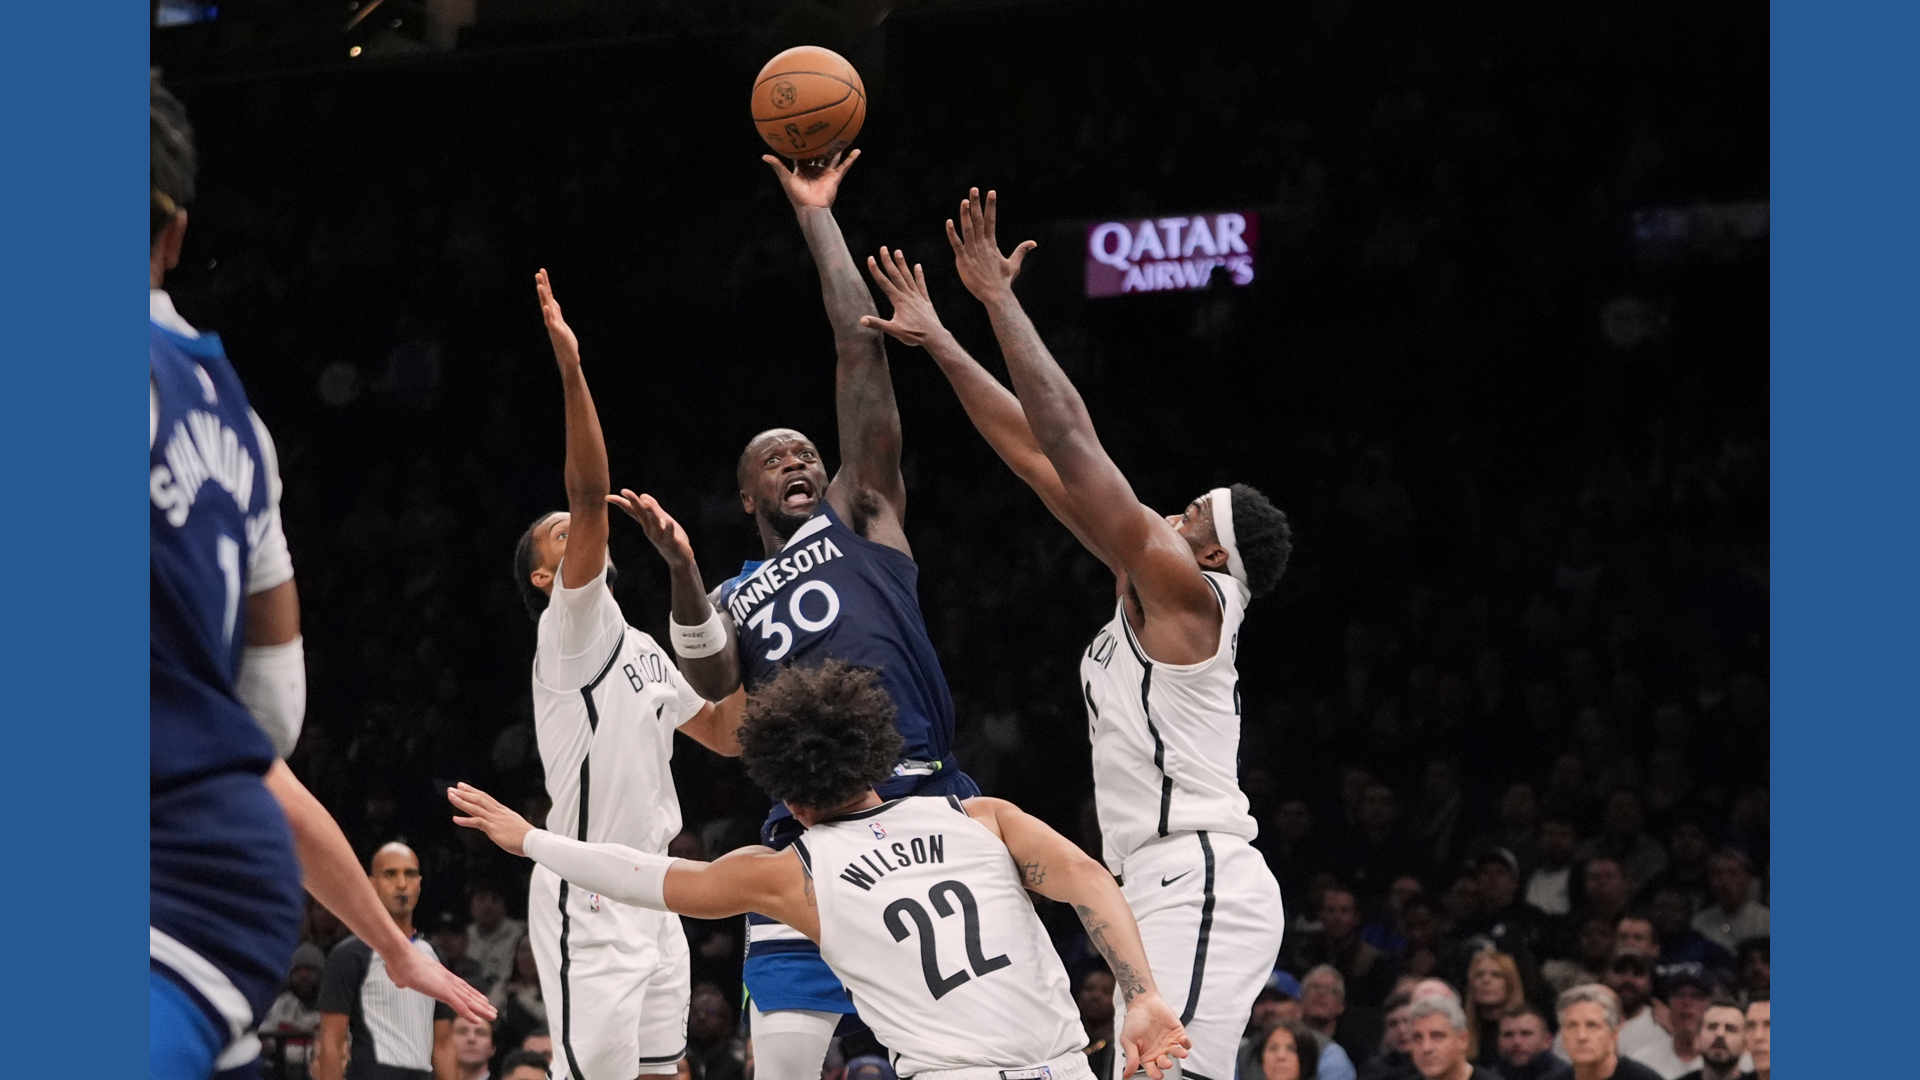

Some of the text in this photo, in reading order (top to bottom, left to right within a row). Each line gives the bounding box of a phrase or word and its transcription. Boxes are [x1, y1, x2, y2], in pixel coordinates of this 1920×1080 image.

[1089, 213, 1249, 270] QATAR
[1122, 253, 1254, 292] AIRWS
[217, 533, 240, 648] 1
[747, 580, 840, 661] 30
[839, 834, 944, 891] WILSON
[883, 880, 1012, 1001] 22
